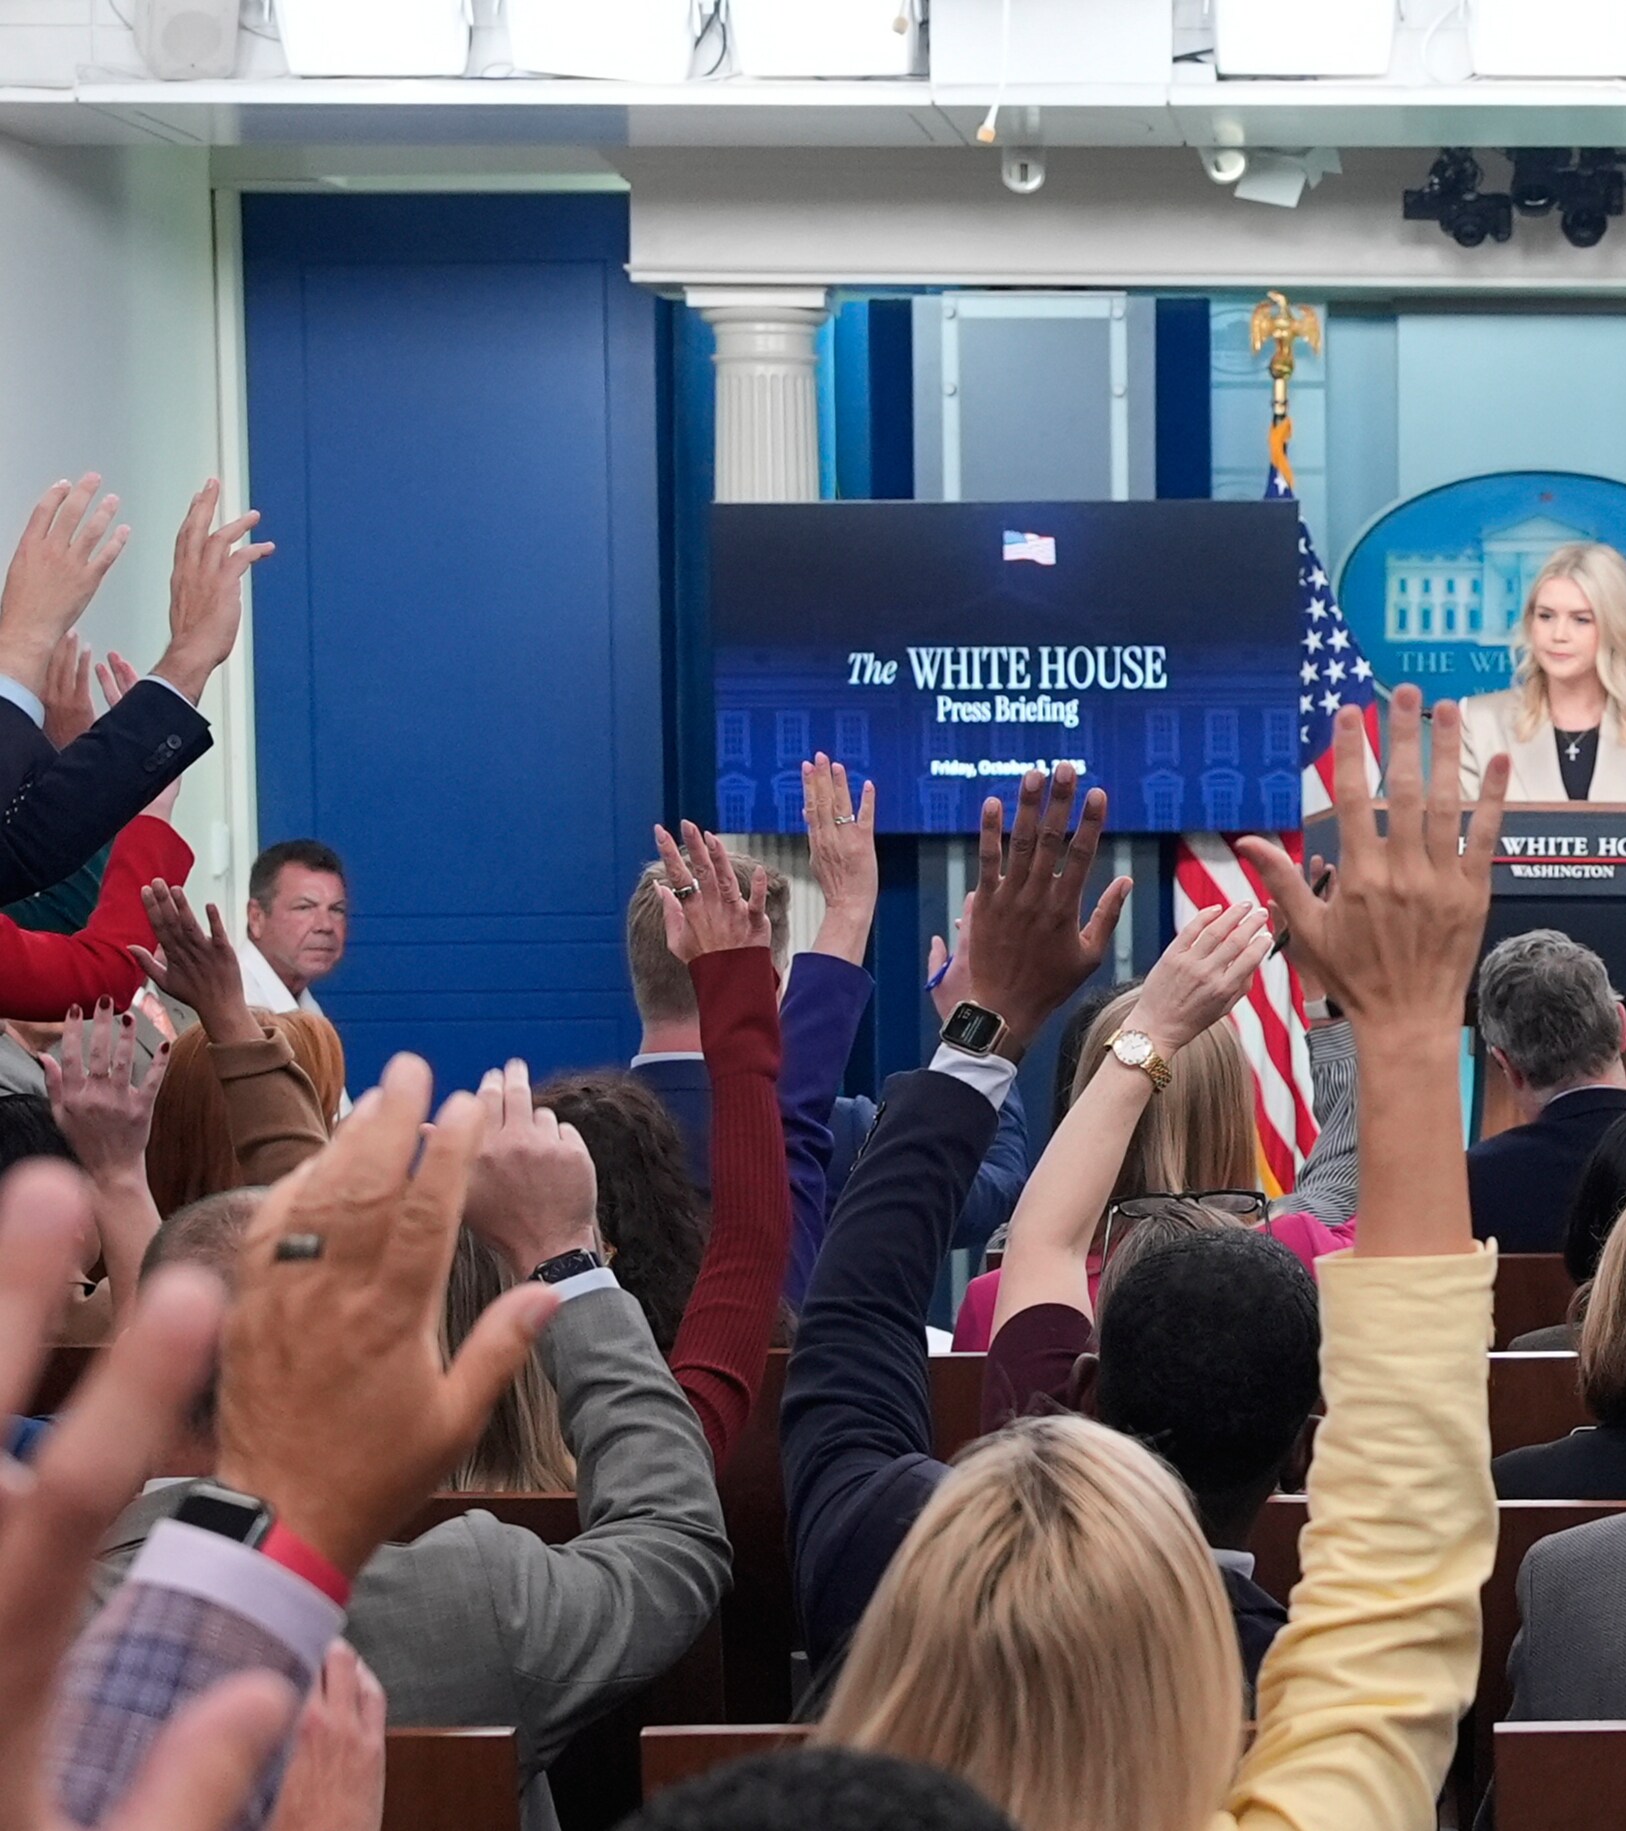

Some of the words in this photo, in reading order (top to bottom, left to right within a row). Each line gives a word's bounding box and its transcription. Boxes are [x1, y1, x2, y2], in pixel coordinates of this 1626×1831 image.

[848, 652, 898, 685] The
[907, 646, 1031, 690] WHITE
[1038, 645, 1168, 690] HOUSE
[1397, 651, 1455, 673] THE
[936, 695, 992, 723] Press
[994, 694, 1080, 728] Briefing
[930, 759, 977, 779] Friday,
[978, 759, 1035, 776] October
[1501, 837, 1589, 857] WHITE
[1510, 864, 1616, 879] WASHINGTON
